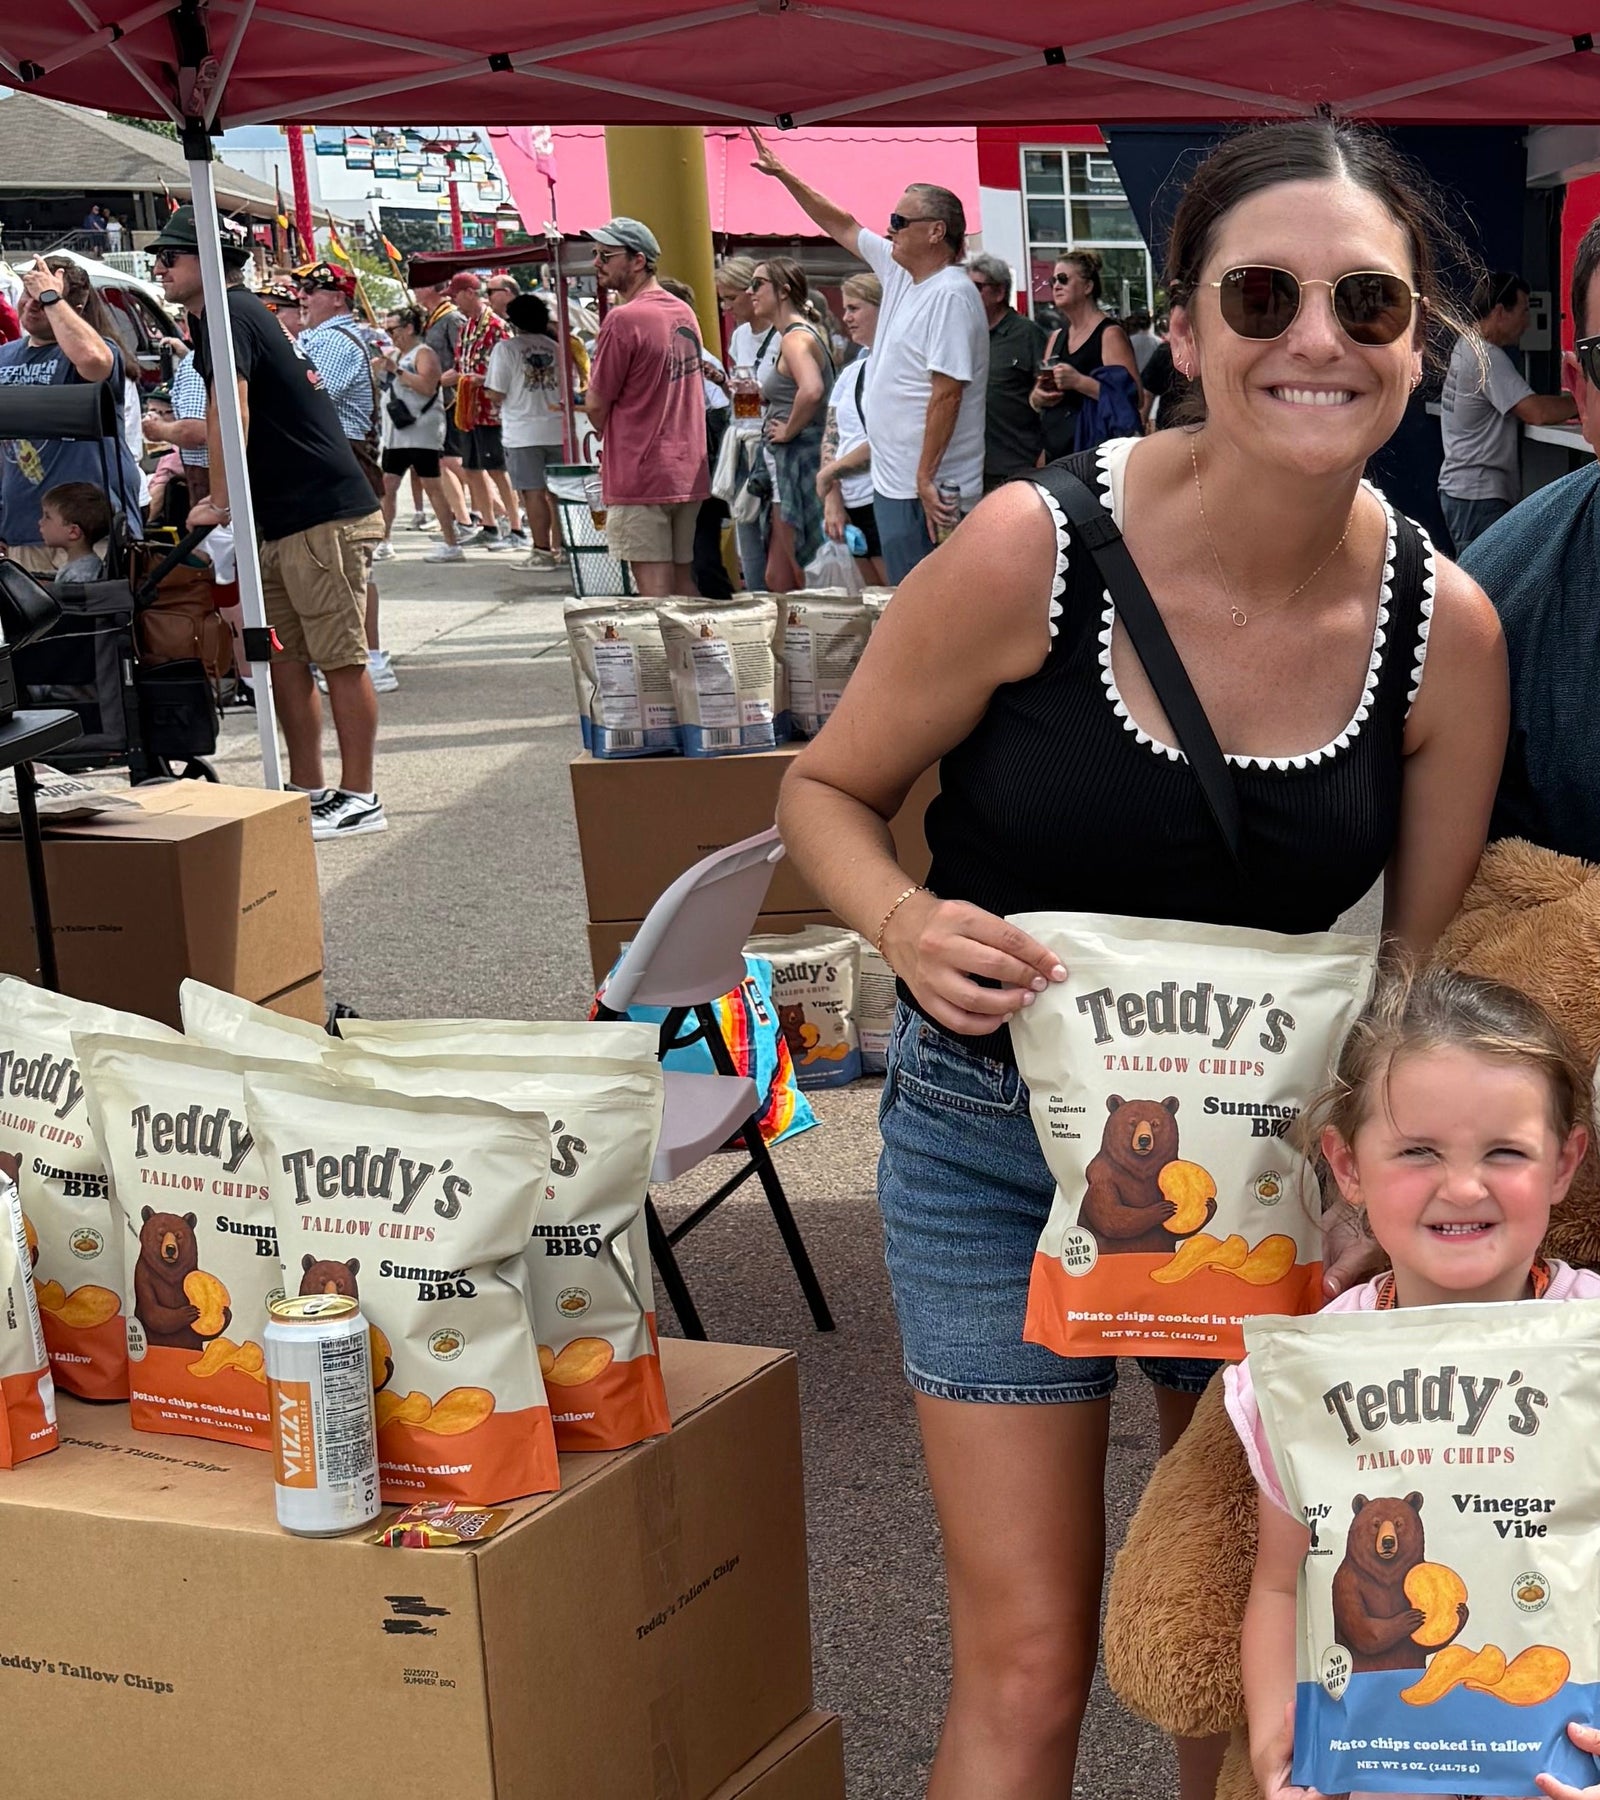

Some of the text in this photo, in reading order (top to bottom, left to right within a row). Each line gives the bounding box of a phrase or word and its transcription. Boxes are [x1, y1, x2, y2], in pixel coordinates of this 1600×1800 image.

[772, 961, 838, 985] eddy's
[1076, 981, 1296, 1055] Teddy's
[1104, 1055, 1265, 1077] TALLOW CHIPS
[0, 1050, 85, 1120] Teddy
[1203, 1097, 1300, 1120] Summer
[0, 1109, 84, 1149] ALLOW CHIPS
[132, 1105, 255, 1174] Teddy
[33, 1157, 108, 1184] Summe
[141, 1168, 270, 1200] TALLOW CHIPS
[282, 1146, 472, 1220] Teddy's
[216, 1215, 277, 1239] Summ
[302, 1215, 436, 1242] TALLOW CHIPS
[531, 1223, 601, 1238] mmer
[545, 1239, 602, 1258] BBQ
[1065, 1245, 1091, 1257] SEED
[1068, 1236, 1083, 1246] NO
[380, 1260, 473, 1282] Summer
[1067, 1256, 1092, 1266] OILS
[418, 1279, 478, 1301] BBQ
[129, 1325, 138, 1333] NO
[1068, 1311, 1113, 1322] potato
[1116, 1311, 1155, 1323] chips
[1157, 1313, 1209, 1325] cooked
[1212, 1314, 1227, 1325] in
[55, 1352, 92, 1365] tallow
[133, 1391, 270, 1422] potato chips cooked in tal
[161, 1411, 178, 1421] NET
[180, 1413, 192, 1421] WT
[552, 1410, 595, 1422] tallow
[1323, 1366, 1548, 1446] Teddy's
[300, 1400, 311, 1442] SELTZER
[30, 1426, 53, 1440] Order
[279, 1392, 302, 1479] VIZZY
[60, 1437, 230, 1473] Teddy's Tallow Chips
[302, 1446, 312, 1472] HARD
[1357, 1447, 1515, 1471] TALLOW CHIPS
[377, 1461, 472, 1475] ooked in tallow
[1452, 1494, 1556, 1516] Vinegar
[1493, 1520, 1548, 1539] Vibe
[636, 1554, 740, 1640] Teddy's Tallow Chips
[1326, 1664, 1348, 1680] SEED
[1329, 1655, 1342, 1667] NO
[0, 1653, 174, 1694] eddy's Tallow Chips
[403, 1668, 439, 1679] 20250723
[403, 1677, 456, 1689] SUMMER BBQ
[1327, 1678, 1347, 1690] OILS
[1370, 1738, 1411, 1752] chips
[1413, 1740, 1468, 1751] cooked
[1471, 1740, 1487, 1751] in
[1490, 1740, 1543, 1752] tallow
[1357, 1761, 1379, 1770] NET
[1381, 1761, 1400, 1770] WT
[1401, 1763, 1407, 1771] 5
[1429, 1763, 1467, 1773] (141.75
[1469, 1764, 1480, 1774] g)
